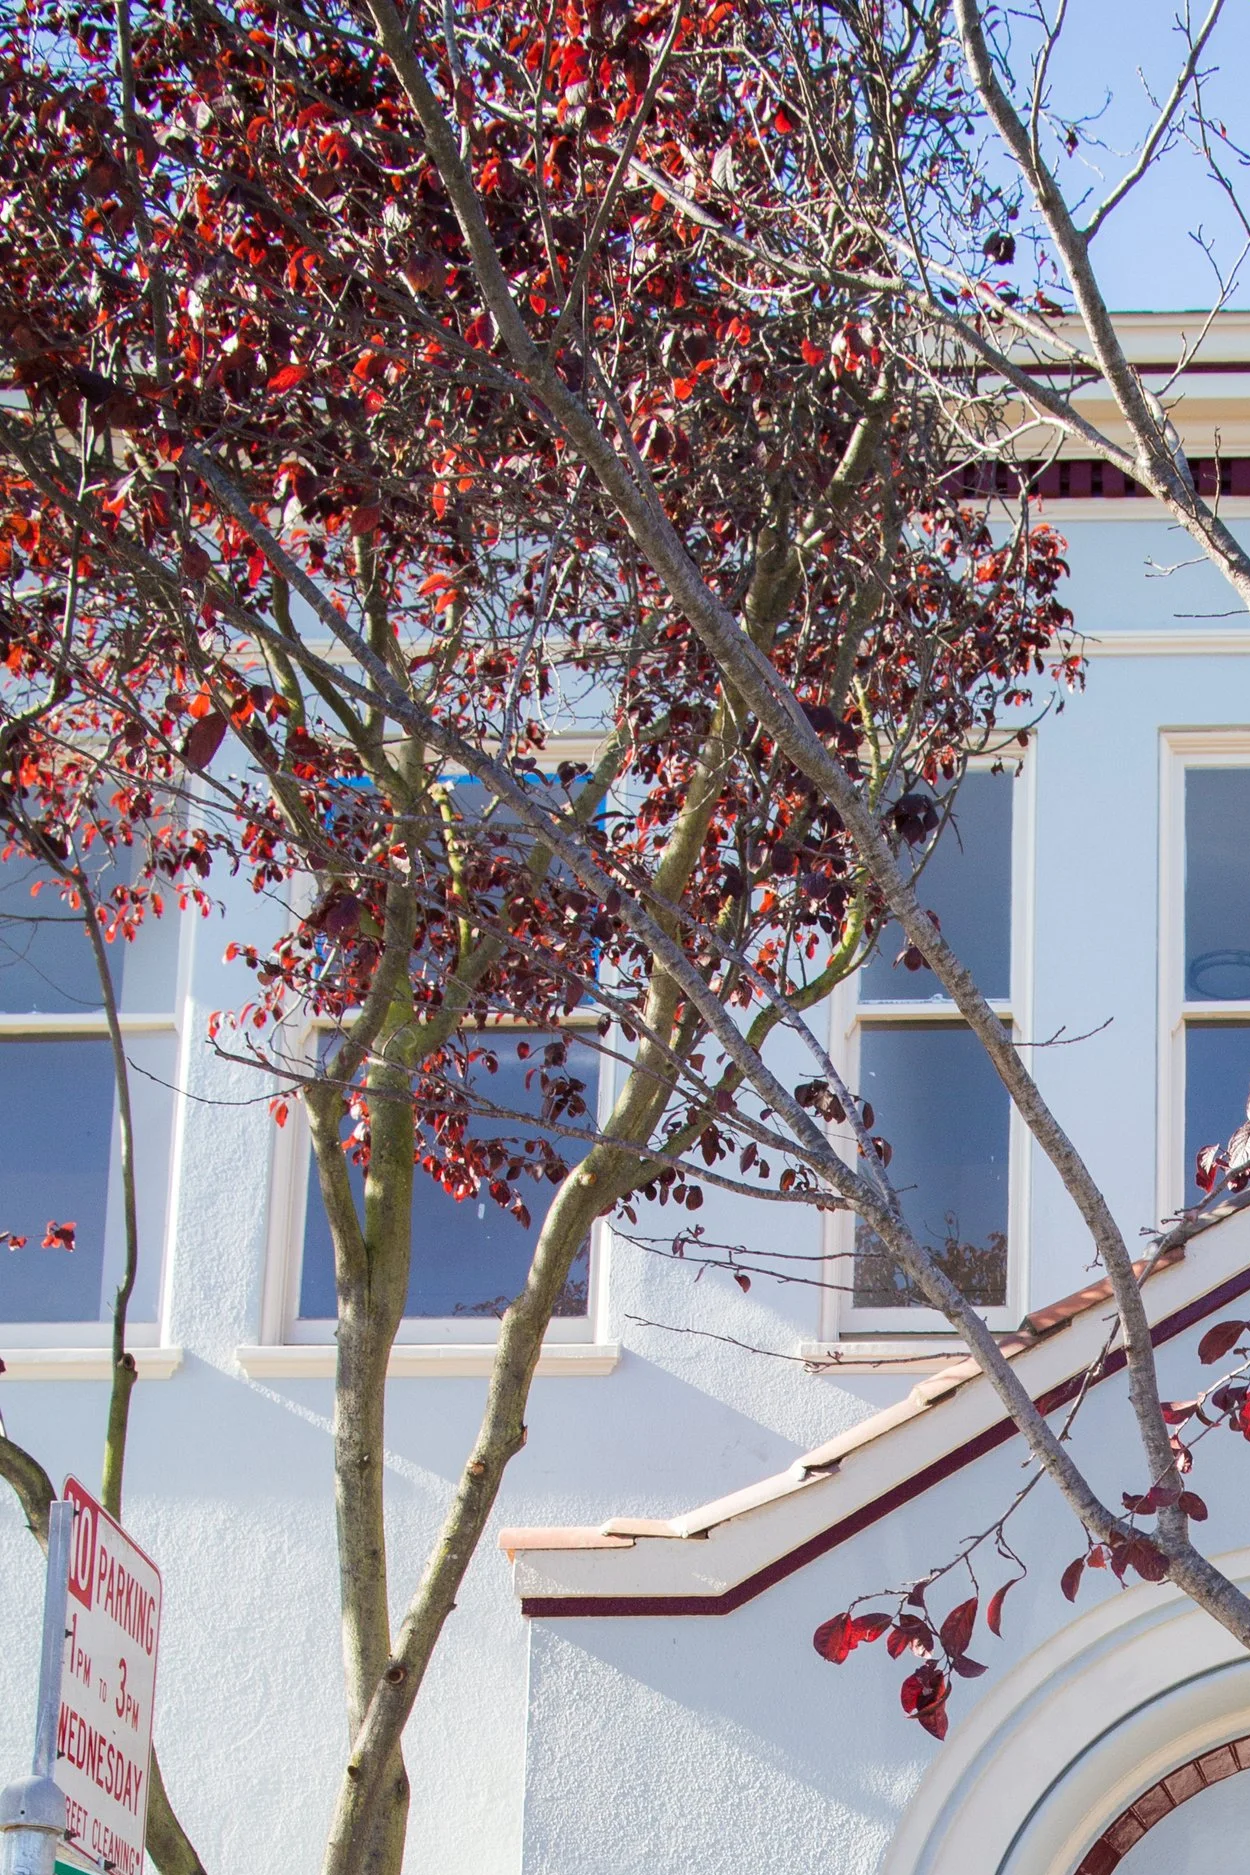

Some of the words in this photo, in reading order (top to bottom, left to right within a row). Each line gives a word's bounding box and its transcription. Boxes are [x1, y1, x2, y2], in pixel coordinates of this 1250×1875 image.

[97, 1544, 156, 1656] PARKING
[98, 1678, 108, 1703] TO
[57, 1701, 143, 1816] WEDNESDAY
[65, 1795, 88, 1841] REET
